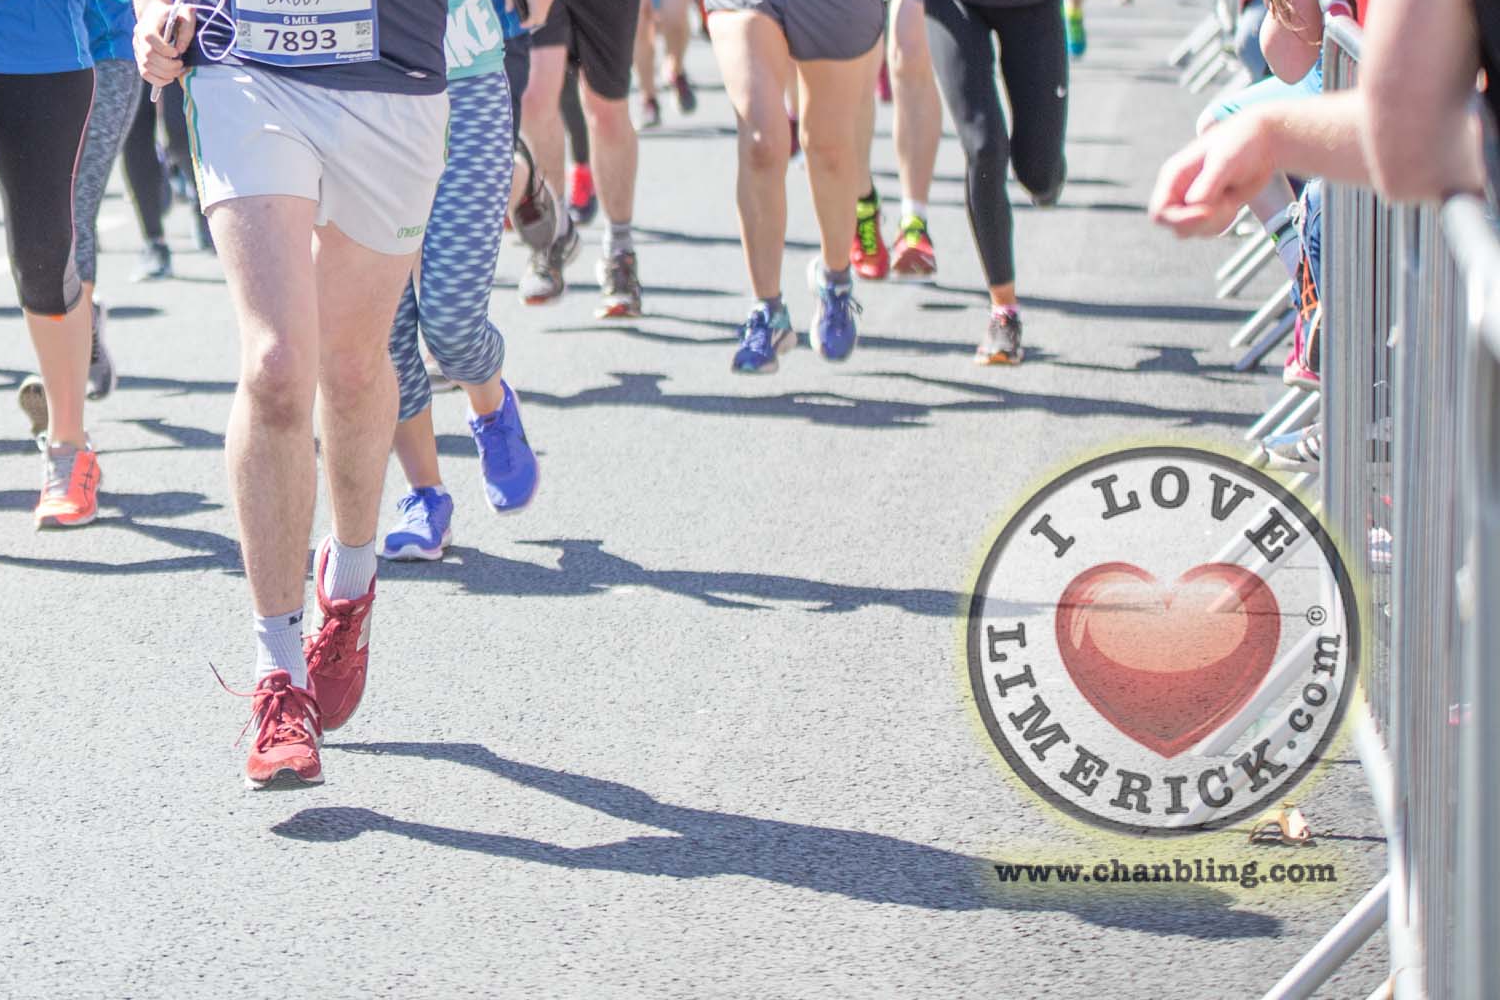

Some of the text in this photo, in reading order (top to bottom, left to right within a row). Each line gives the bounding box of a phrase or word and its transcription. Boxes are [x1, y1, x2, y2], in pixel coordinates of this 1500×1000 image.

[283, 15, 319, 25] 6 MILE
[263, 29, 338, 52] 7893
